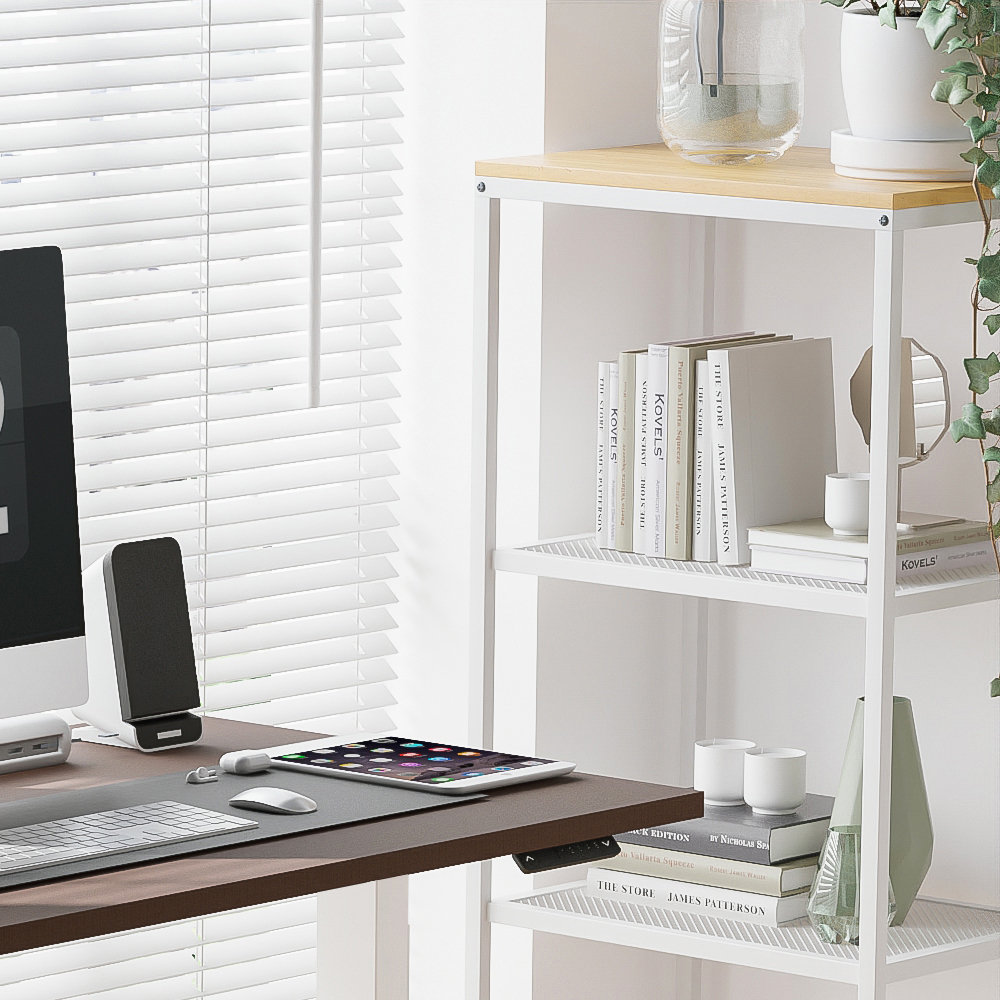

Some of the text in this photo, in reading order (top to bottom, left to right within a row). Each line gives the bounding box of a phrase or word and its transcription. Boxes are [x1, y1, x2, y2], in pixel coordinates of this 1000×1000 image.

[654, 393, 665, 461] KOVELS'
[676, 393, 684, 427] Vallarta
[610, 408, 618, 464] KOVELS'
[714, 363, 730, 553] THE STORE JAMES PATTERSON
[901, 555, 938, 571] KOVELS'
[651, 829, 690, 842] EDITION
[631, 851, 661, 864] Vallarta
[597, 880, 766, 916] THE STORE JAMES PATTERSON
